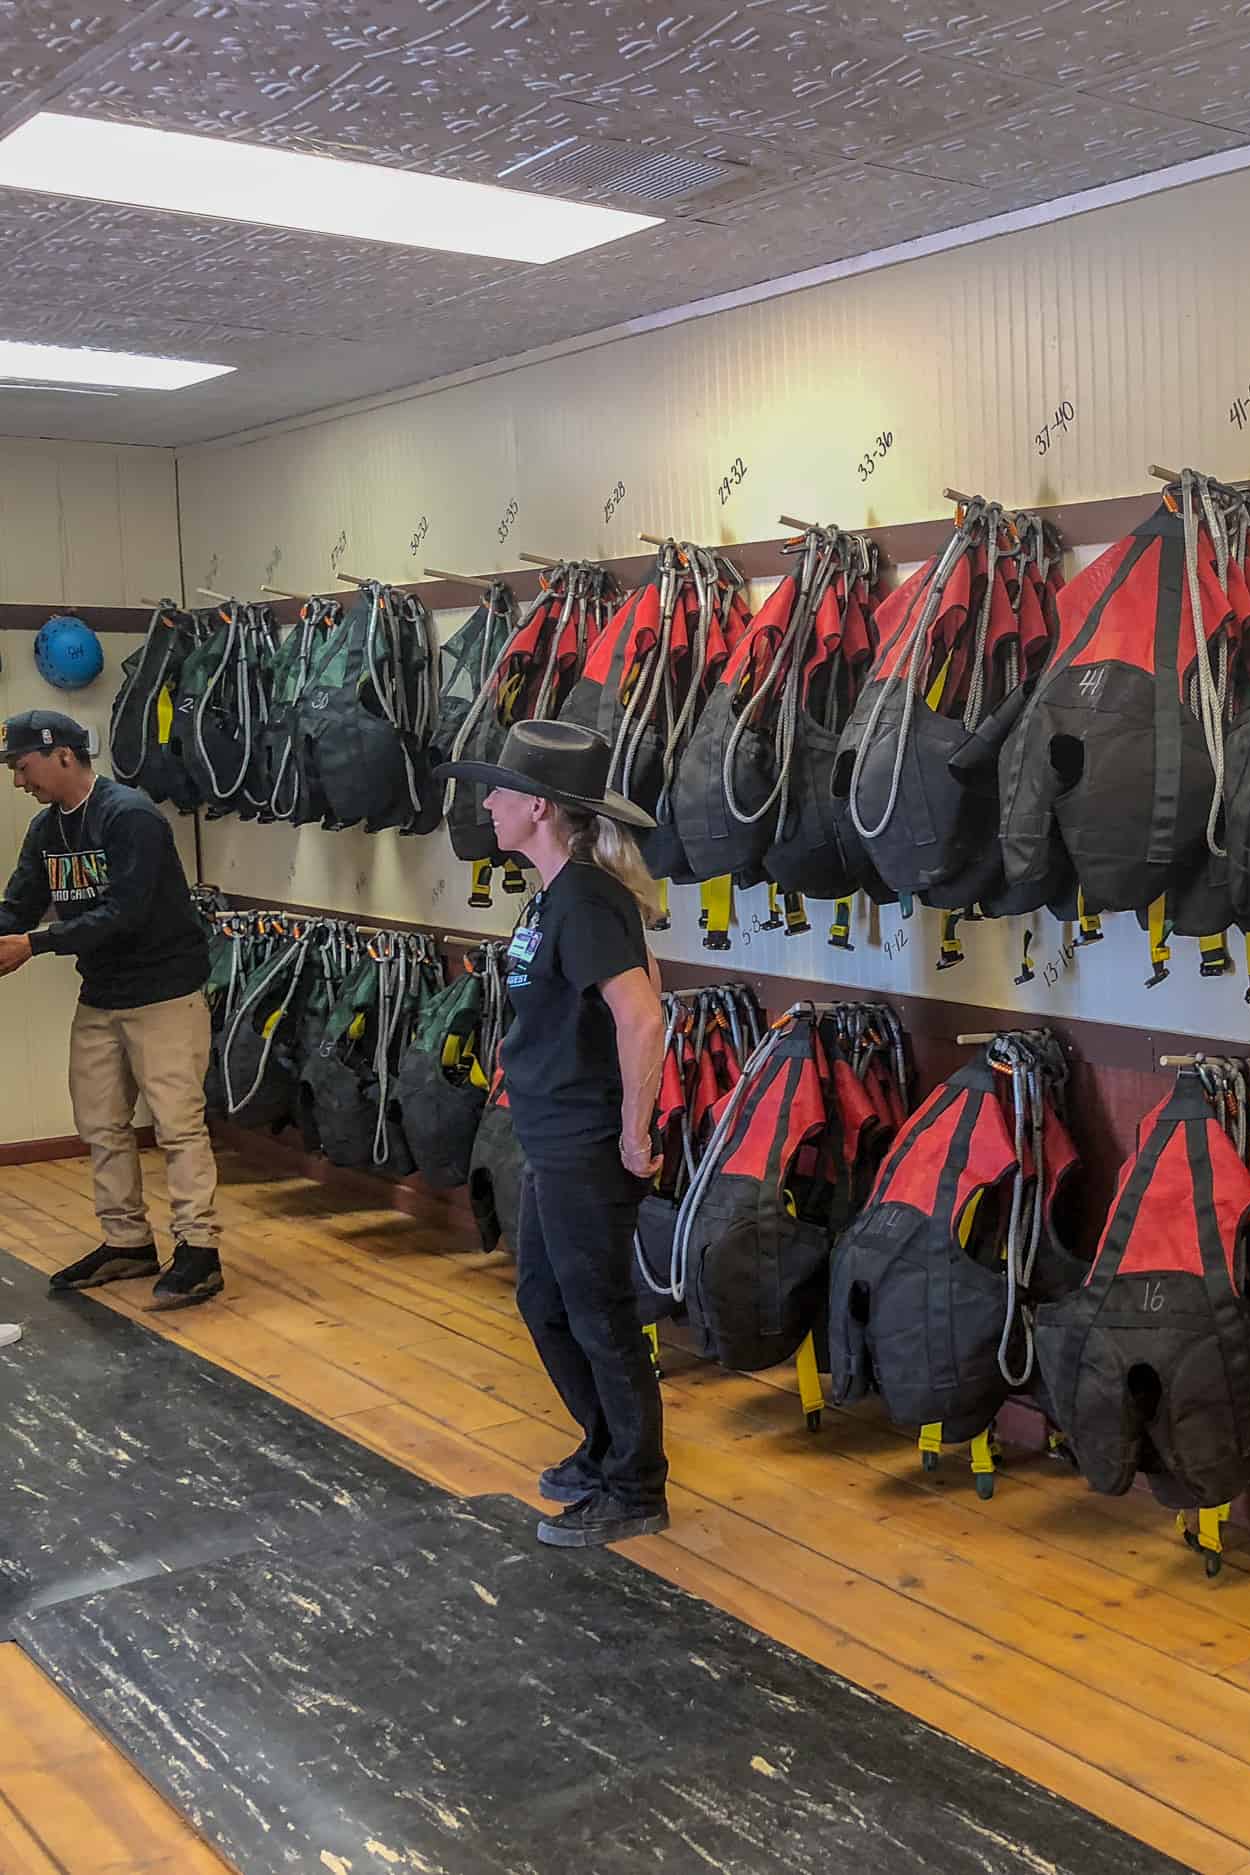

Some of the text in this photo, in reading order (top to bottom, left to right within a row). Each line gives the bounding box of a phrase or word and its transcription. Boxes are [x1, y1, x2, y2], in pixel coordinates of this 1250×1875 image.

[1034, 400, 1075, 456] 37-40
[718, 456, 748, 505] 29-32
[857, 431, 894, 482] 33-36
[883, 928, 909, 961] 9-12
[1143, 1280, 1165, 1312] 16
